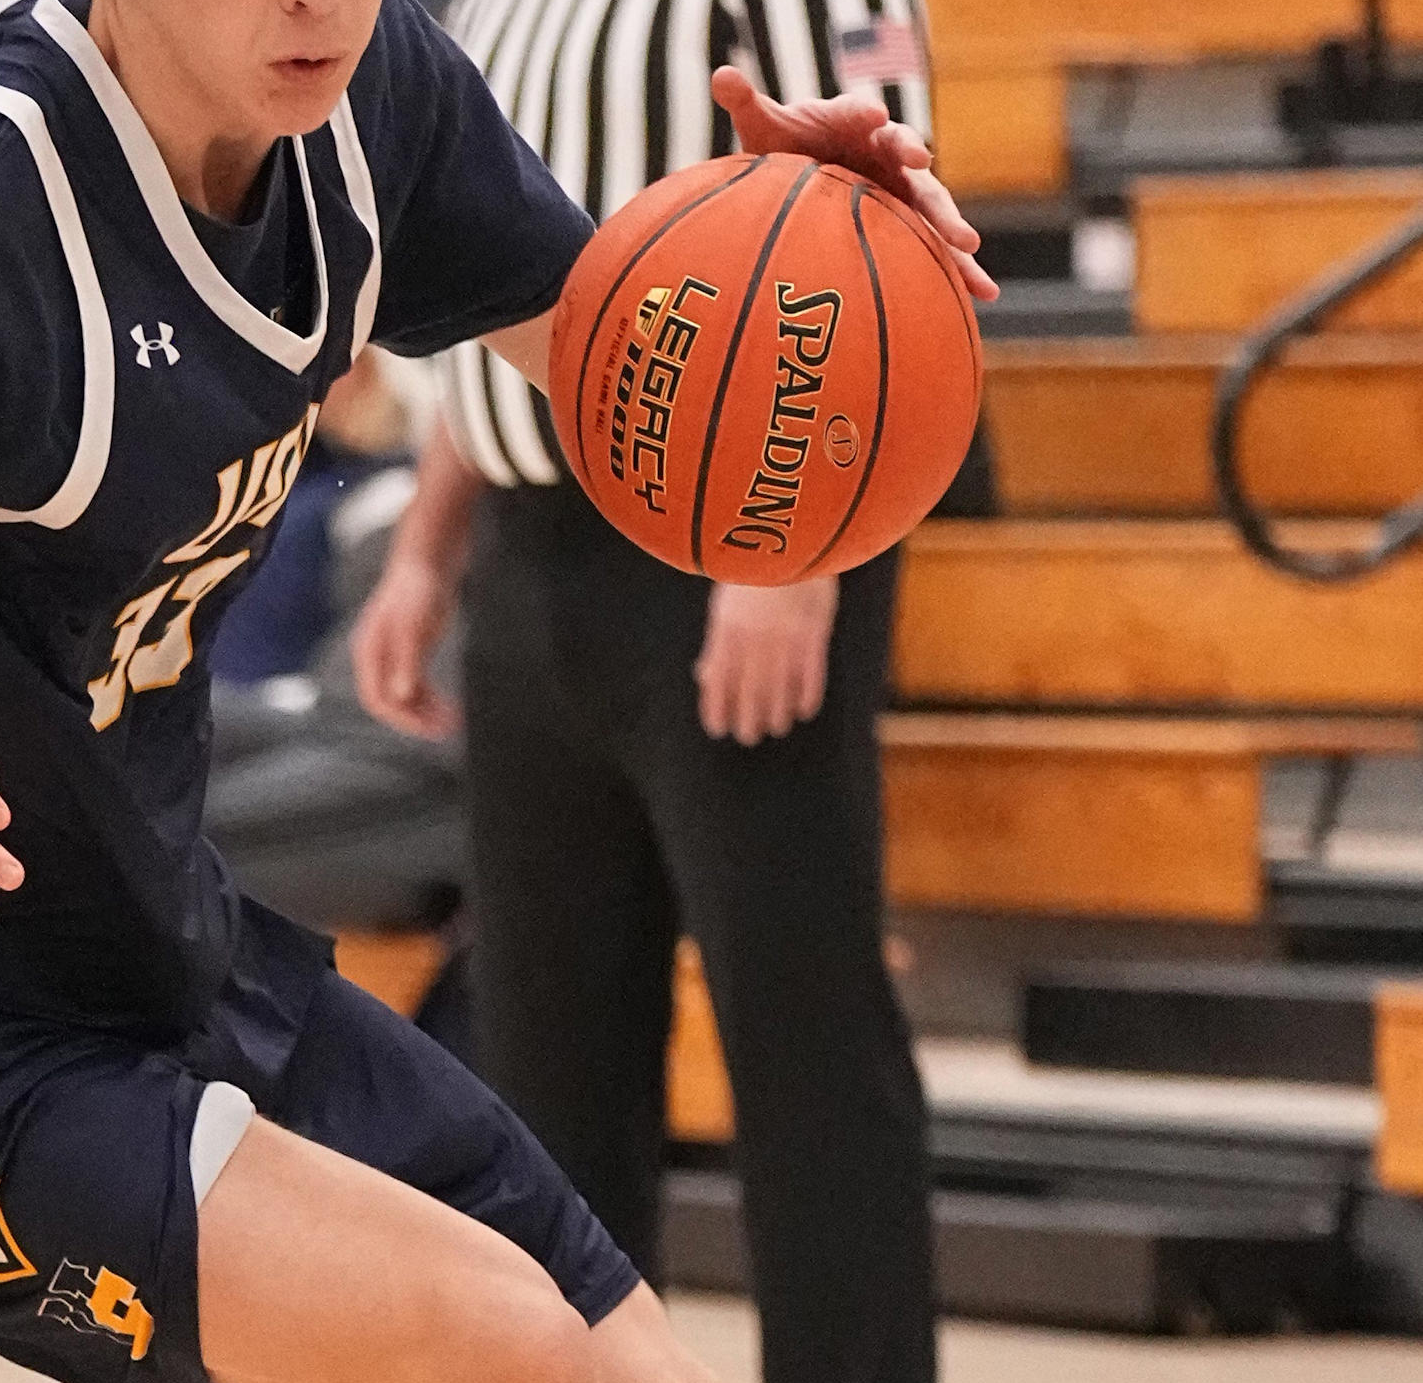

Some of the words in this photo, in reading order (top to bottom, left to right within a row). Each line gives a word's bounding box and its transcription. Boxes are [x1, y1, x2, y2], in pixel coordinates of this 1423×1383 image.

[597, 373, 612, 405] GAME
[605, 317, 630, 370] OFFICIAL
[610, 340, 644, 482] 1000
[632, 274, 721, 515] LEGACY
[721, 281, 843, 555] SPALDING
